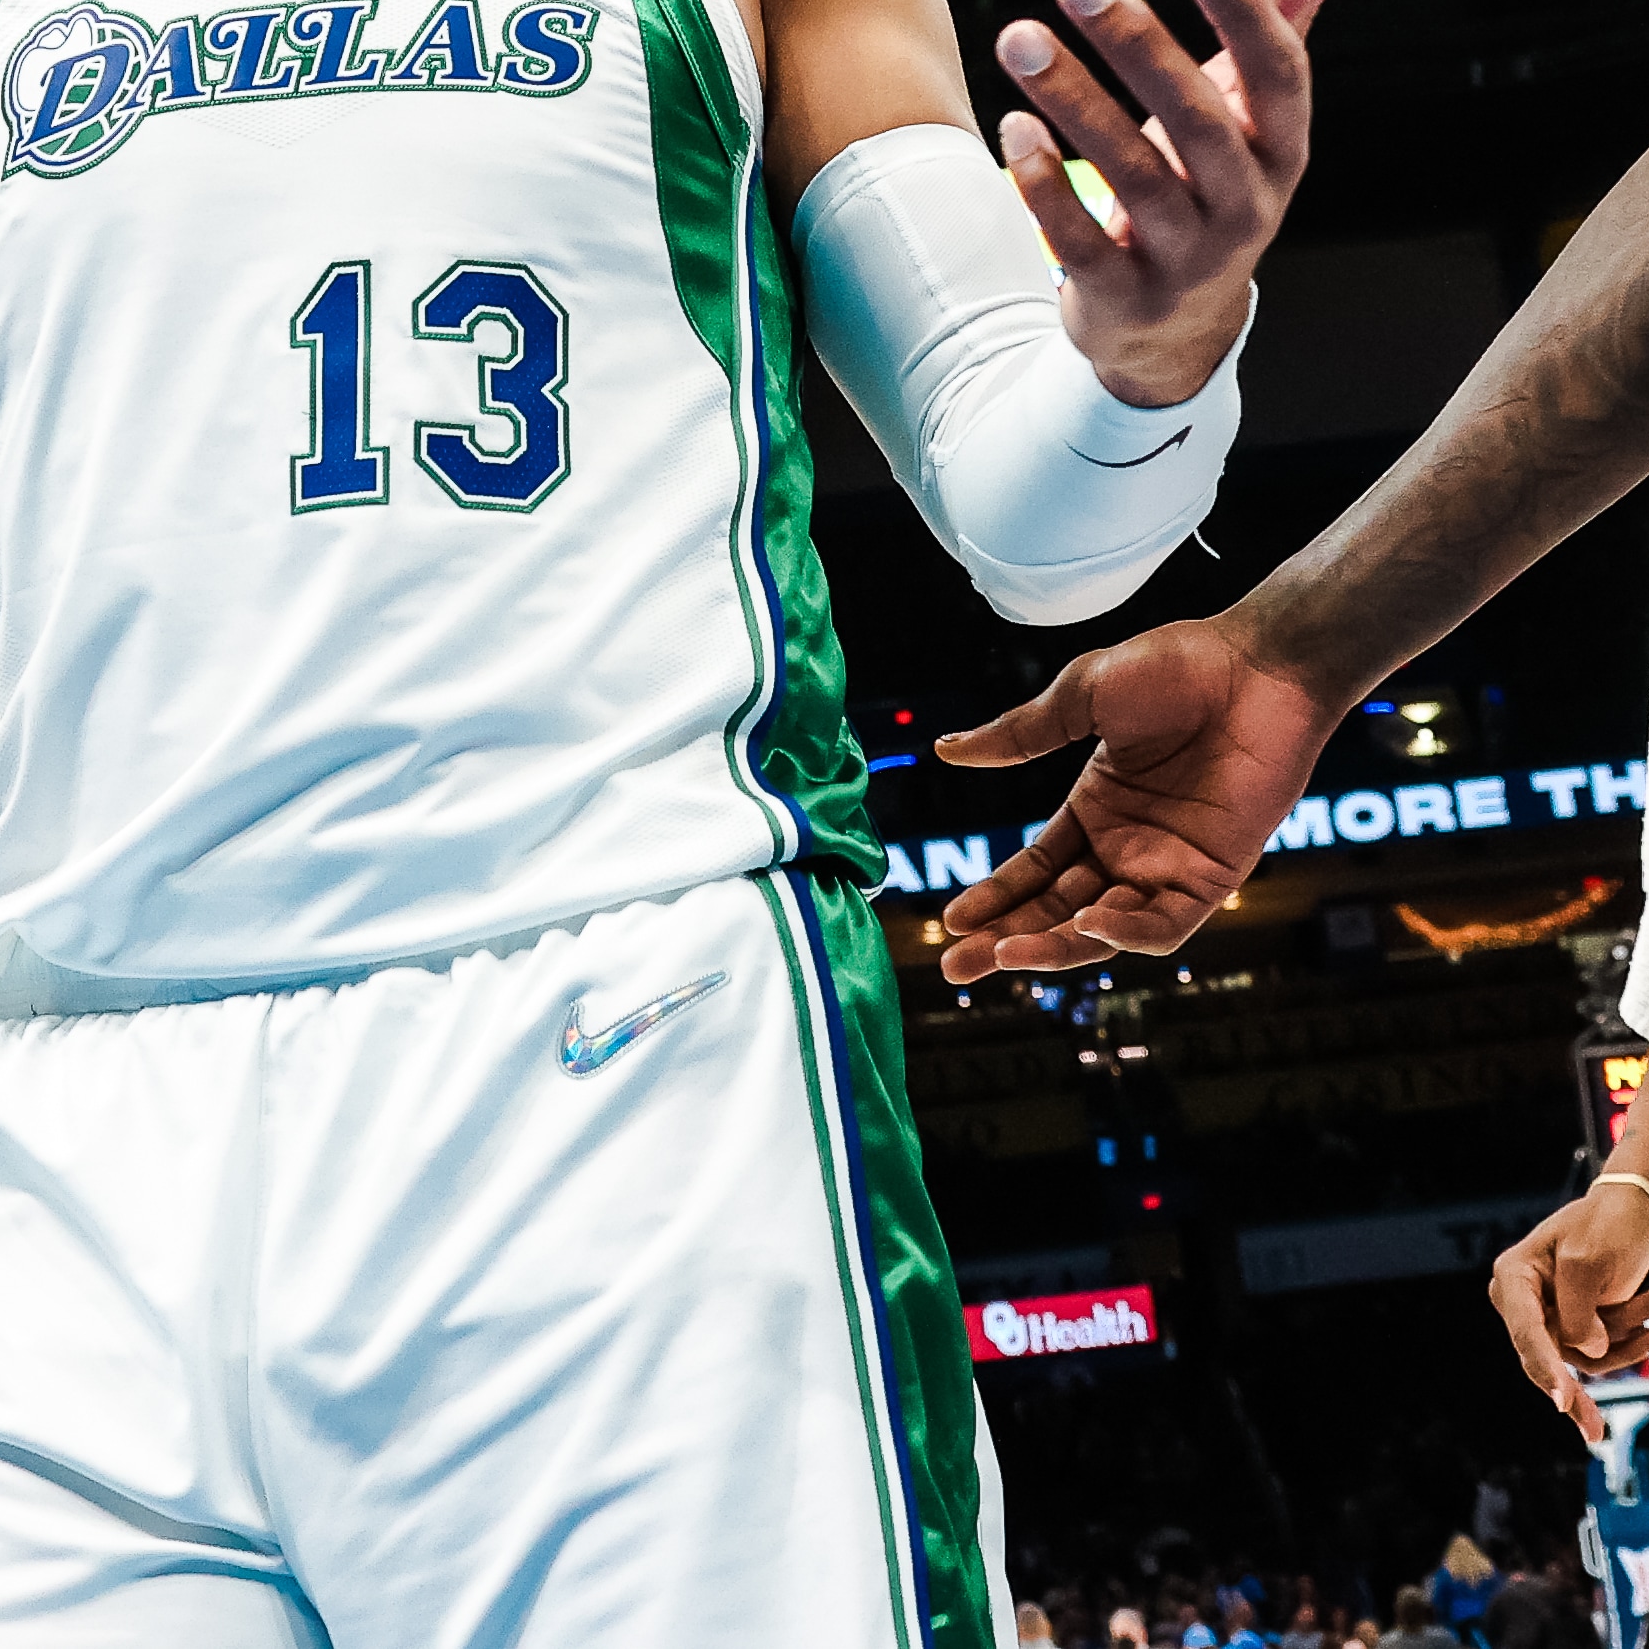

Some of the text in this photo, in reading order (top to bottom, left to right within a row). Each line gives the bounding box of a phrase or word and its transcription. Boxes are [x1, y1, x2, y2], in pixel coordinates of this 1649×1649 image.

[291, 260, 570, 514] 13
[1263, 759, 1646, 853] MORE TH
